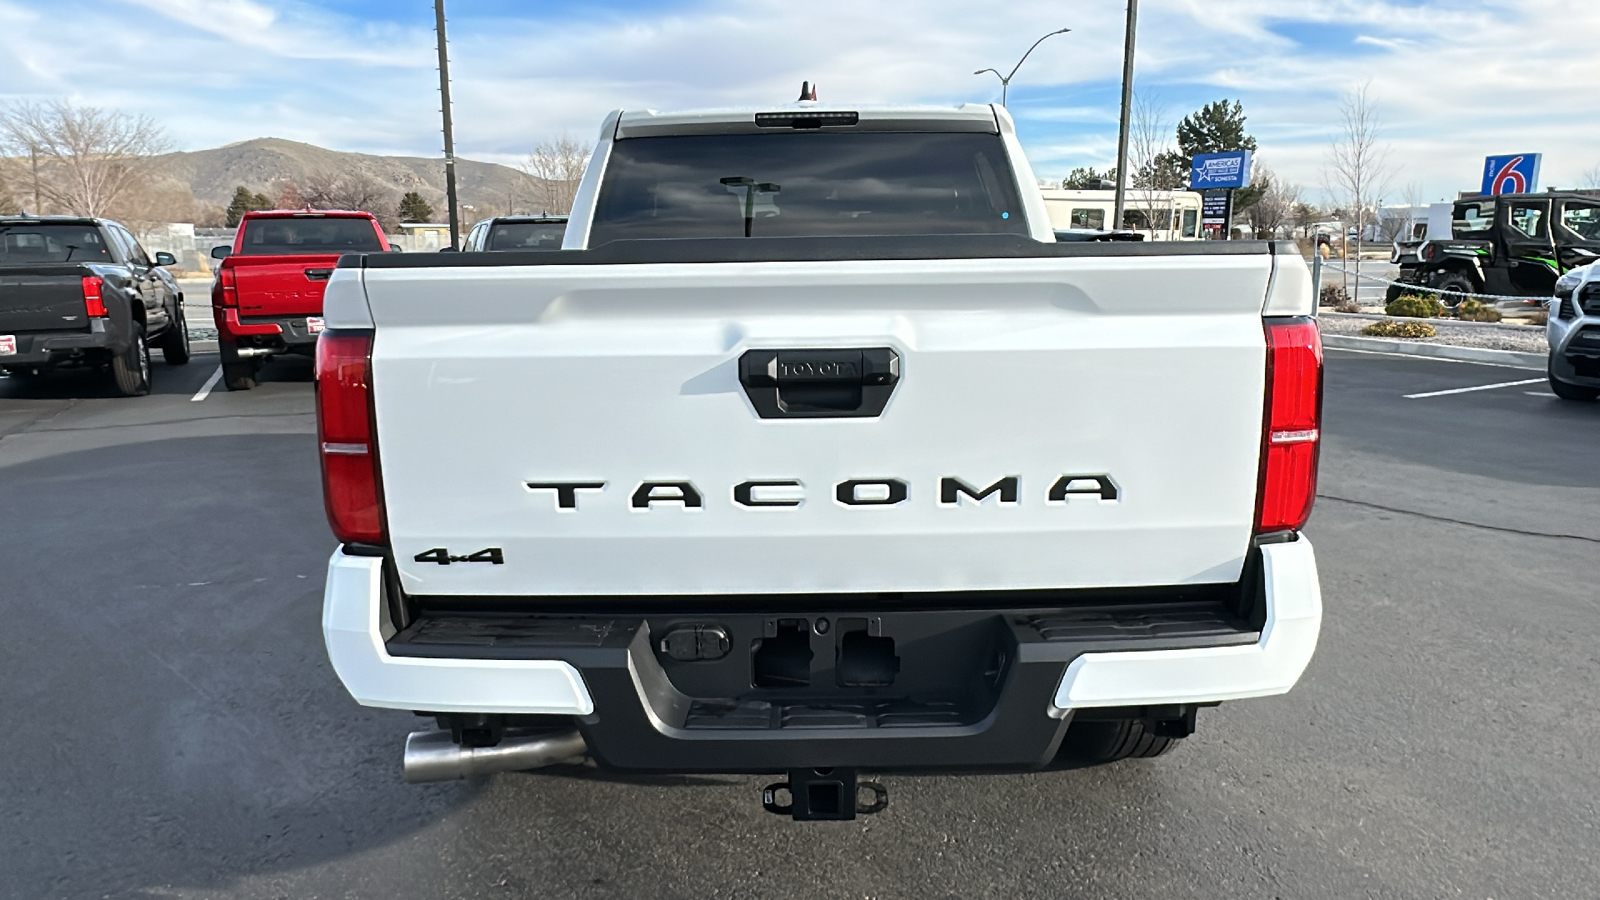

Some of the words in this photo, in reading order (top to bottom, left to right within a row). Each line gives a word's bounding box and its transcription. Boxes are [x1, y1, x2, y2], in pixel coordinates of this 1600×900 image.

[1207, 159, 1239, 168] AMERICAS
[1491, 155, 1526, 195] 6
[781, 361, 857, 377] TOYOTA
[522, 472, 1121, 515] TACOMA
[414, 547, 504, 565] 4x4
